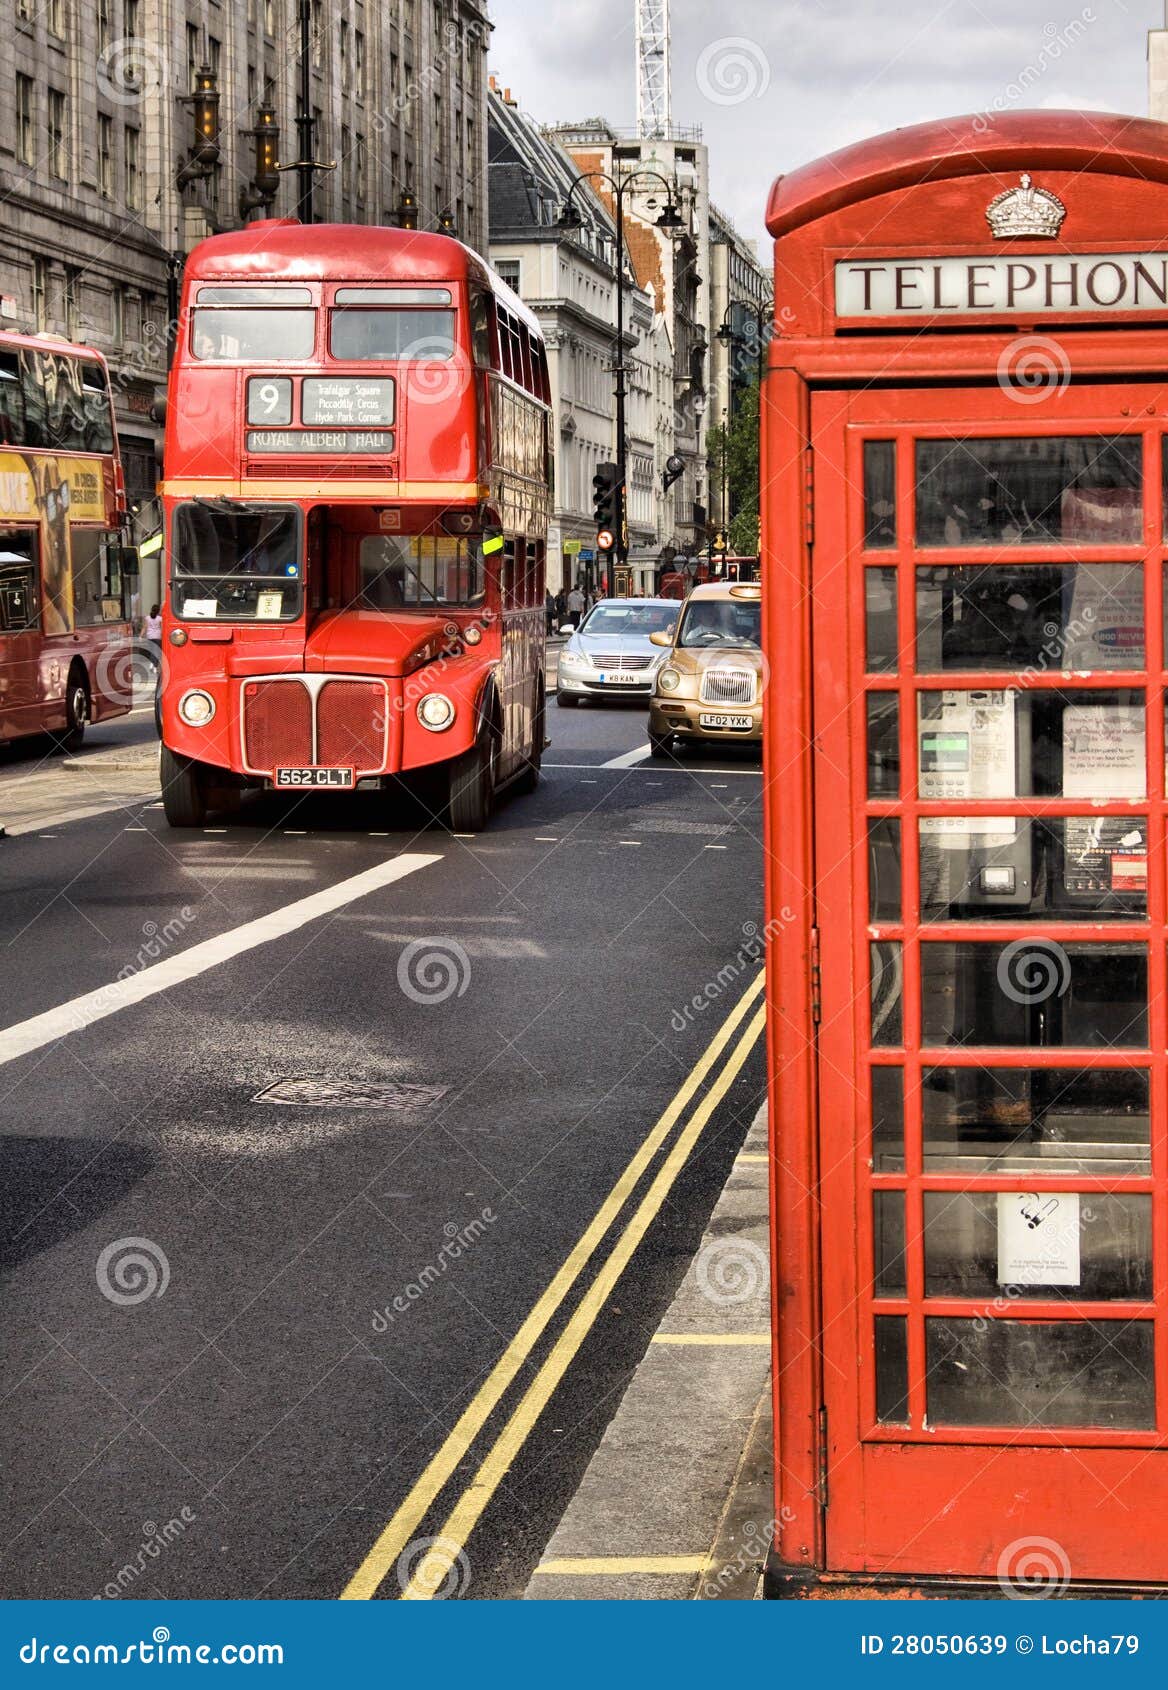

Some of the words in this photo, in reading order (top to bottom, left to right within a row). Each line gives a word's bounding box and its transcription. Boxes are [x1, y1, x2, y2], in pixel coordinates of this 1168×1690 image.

[848, 260, 1168, 311] TELEPHON
[318, 384, 351, 397] Trafalgar
[356, 384, 381, 397] Square
[259, 384, 280, 414] 9
[318, 398, 354, 410] Piccadilly
[357, 398, 380, 409] Circus
[315, 411, 335, 424] Hyde
[338, 411, 354, 422] Park
[358, 411, 382, 422] Corner
[252, 432, 293, 447] ROYAL
[300, 432, 347, 447] ALBERT
[355, 432, 387, 447] HALL
[460, 514, 474, 532] 9
[619, 675, 634, 683] KAN
[703, 715, 728, 726] LF02
[730, 716, 748, 726] YXK
[279, 769, 312, 785] 562
[316, 769, 349, 785] CLT
